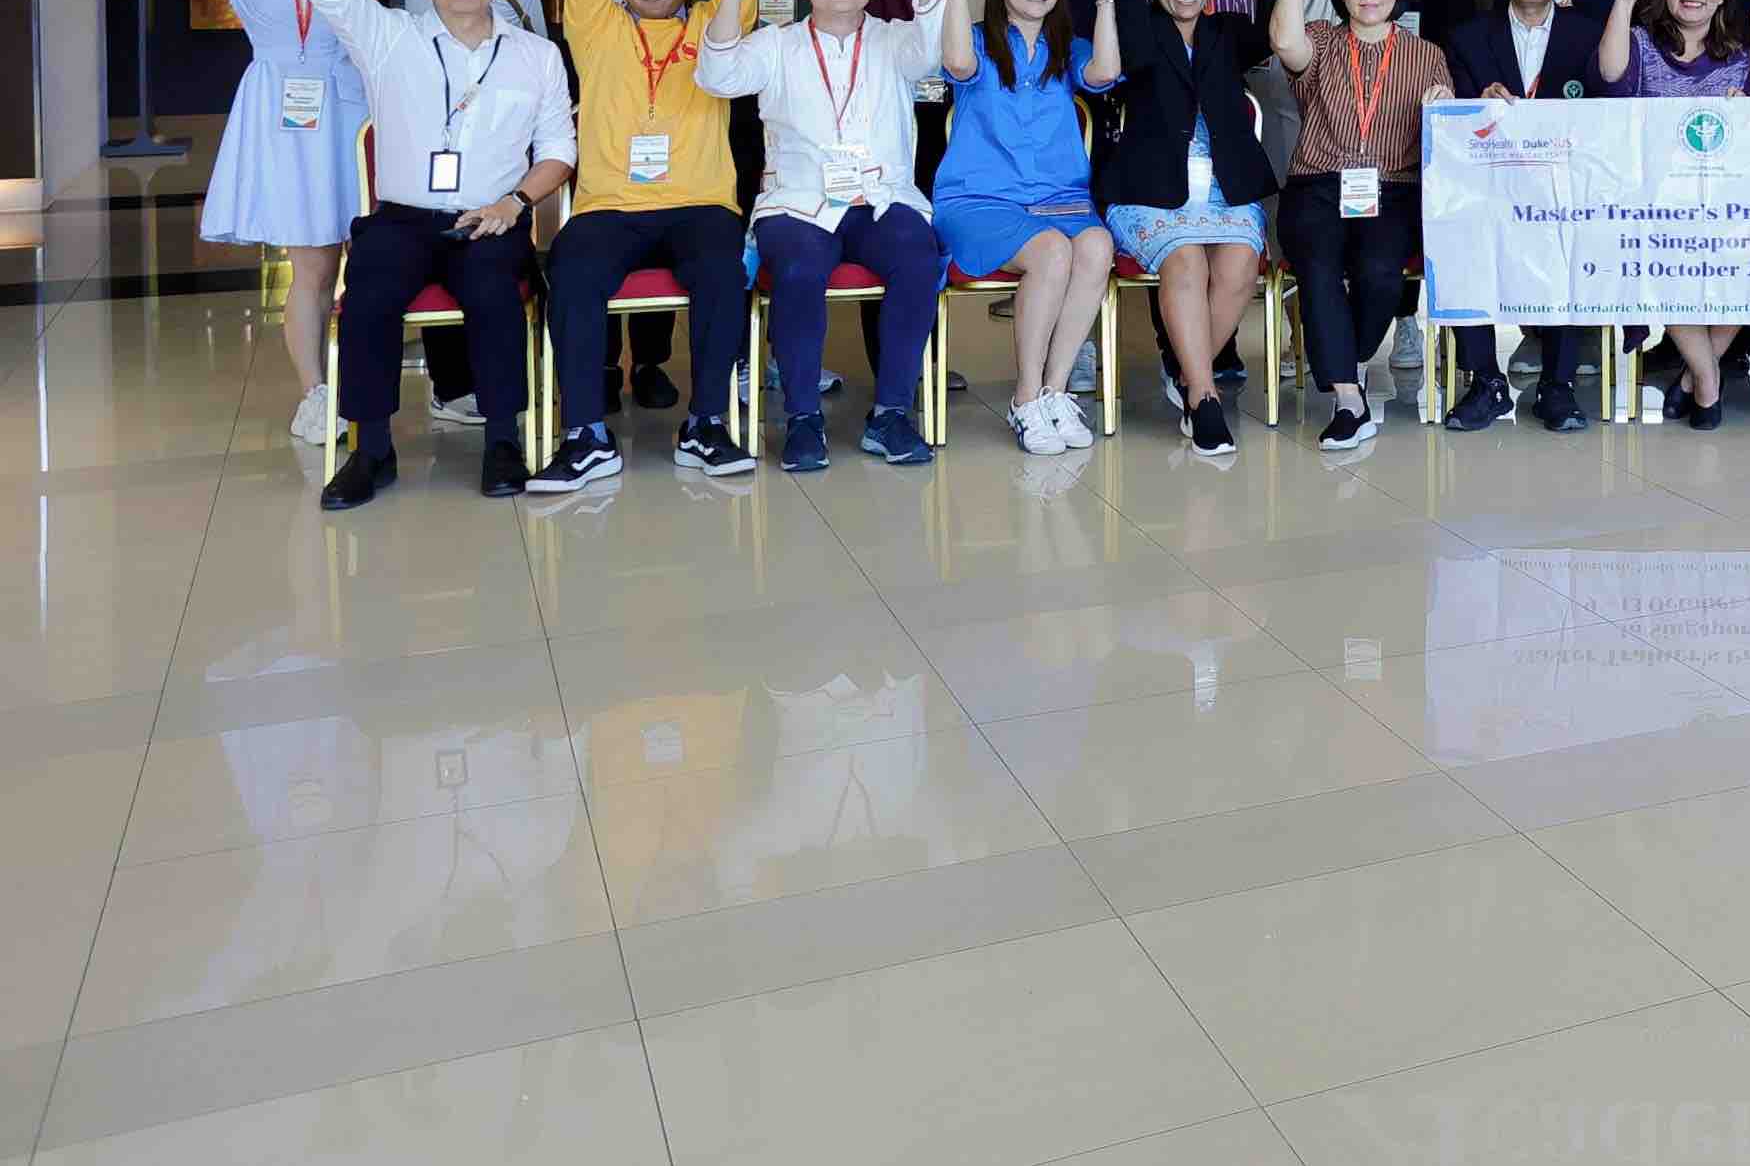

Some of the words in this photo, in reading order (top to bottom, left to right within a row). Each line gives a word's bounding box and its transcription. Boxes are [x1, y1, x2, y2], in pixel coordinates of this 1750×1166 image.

[1512, 204, 1596, 222] Master
[1601, 202, 1719, 221] Trainer's
[1618, 233, 1641, 250] in
[1582, 262, 1597, 278] 9
[1620, 261, 1642, 278] 13
[1647, 260, 1740, 278] October
[1499, 302, 1554, 314] Institute
[1557, 302, 1571, 314] of
[1573, 302, 1632, 314] Geriatric
